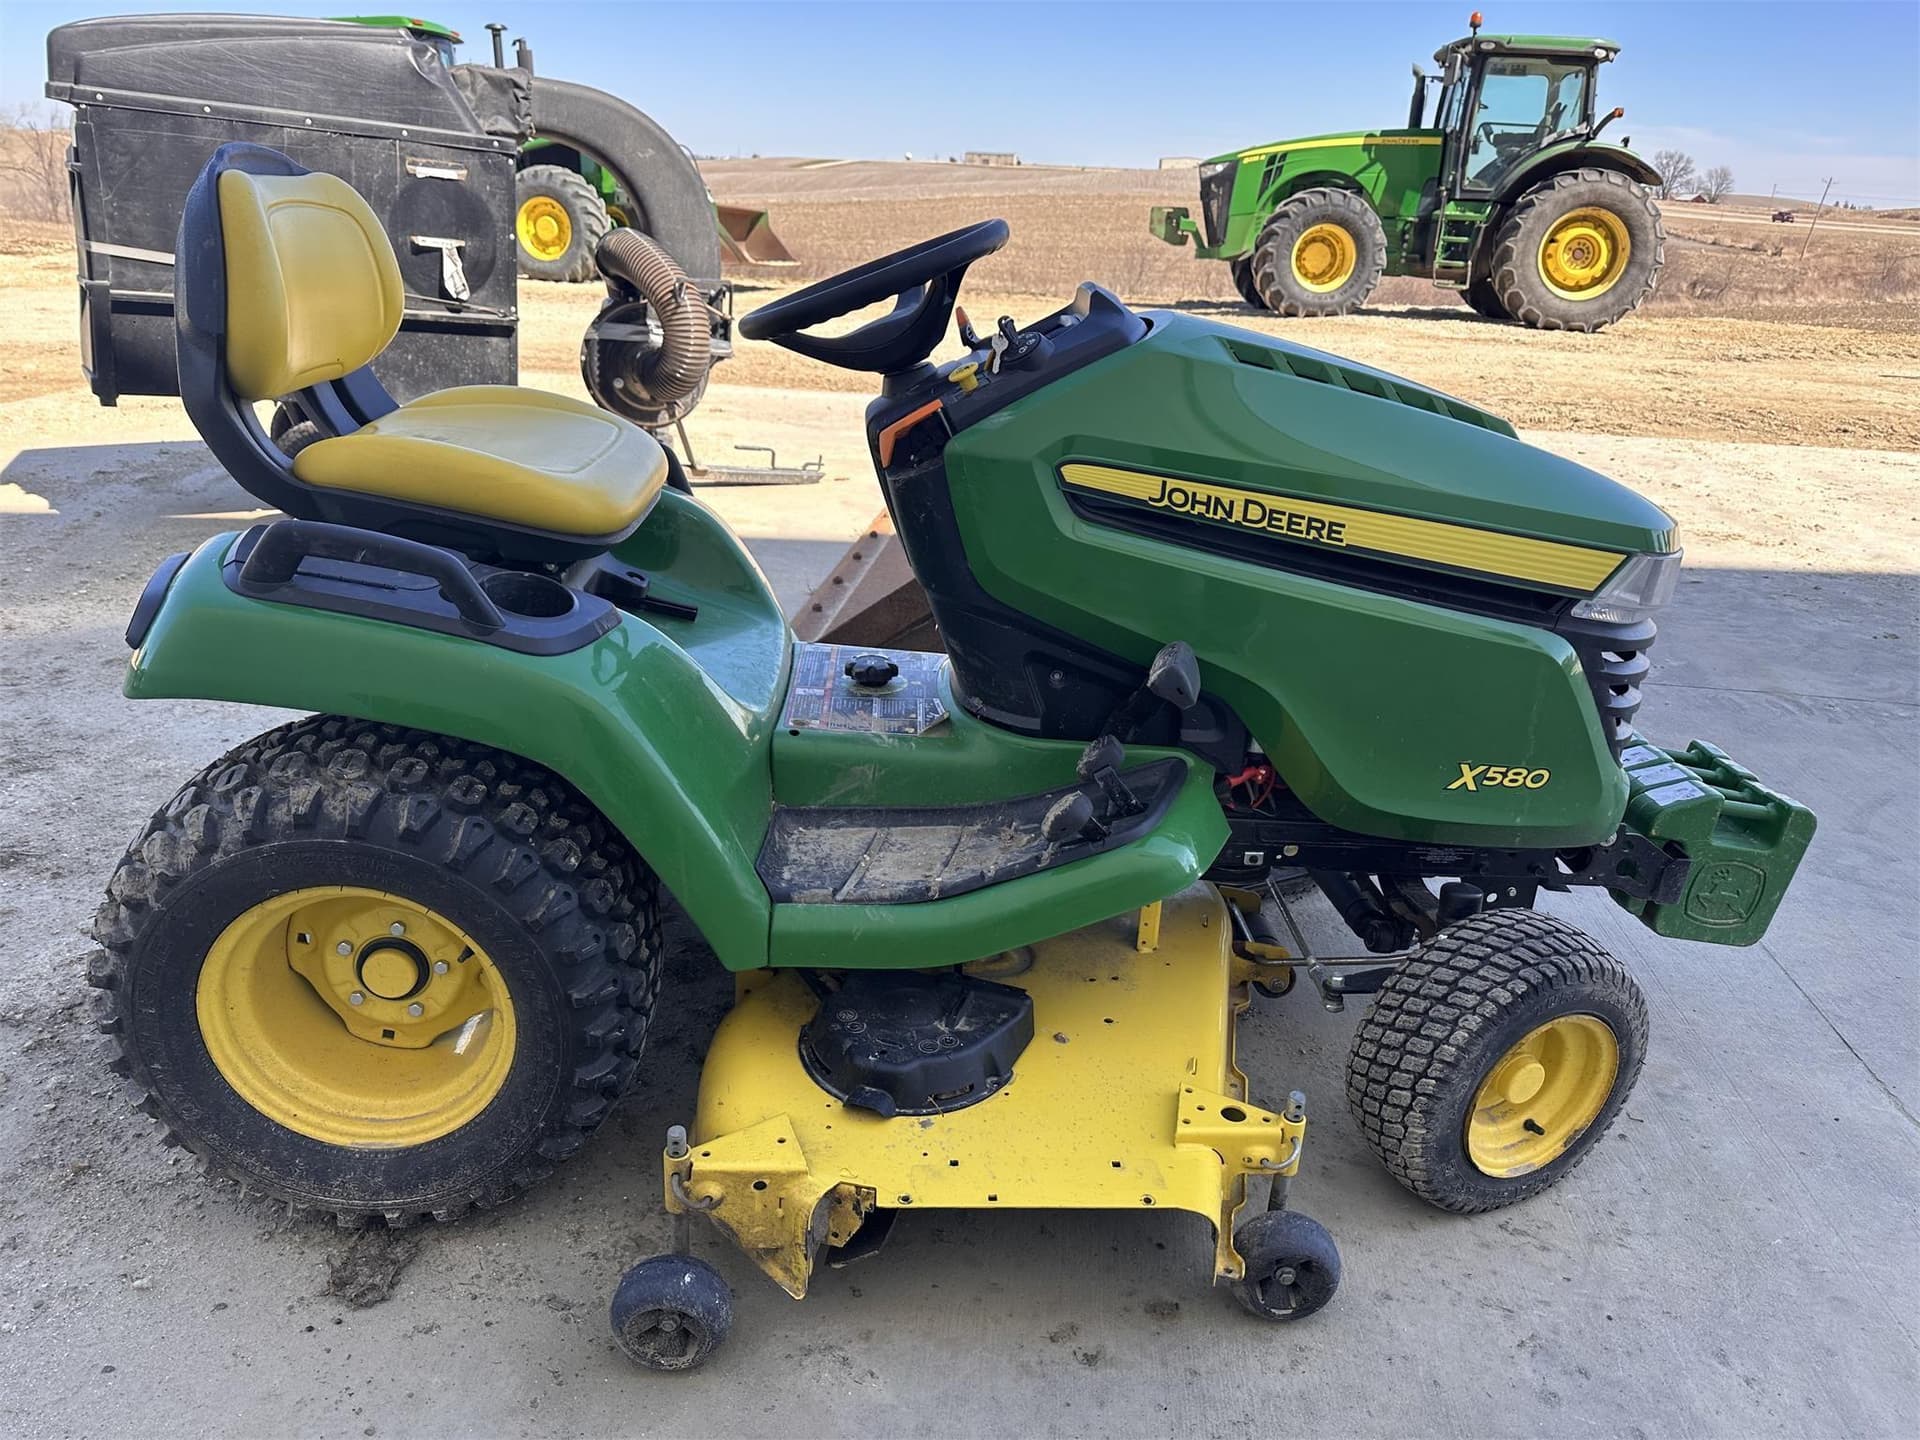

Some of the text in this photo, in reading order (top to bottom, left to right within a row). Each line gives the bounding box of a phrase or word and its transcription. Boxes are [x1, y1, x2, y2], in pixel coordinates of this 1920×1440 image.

[1148, 480, 1347, 544] JOHN DEERE
[1443, 762, 1551, 791] X580
